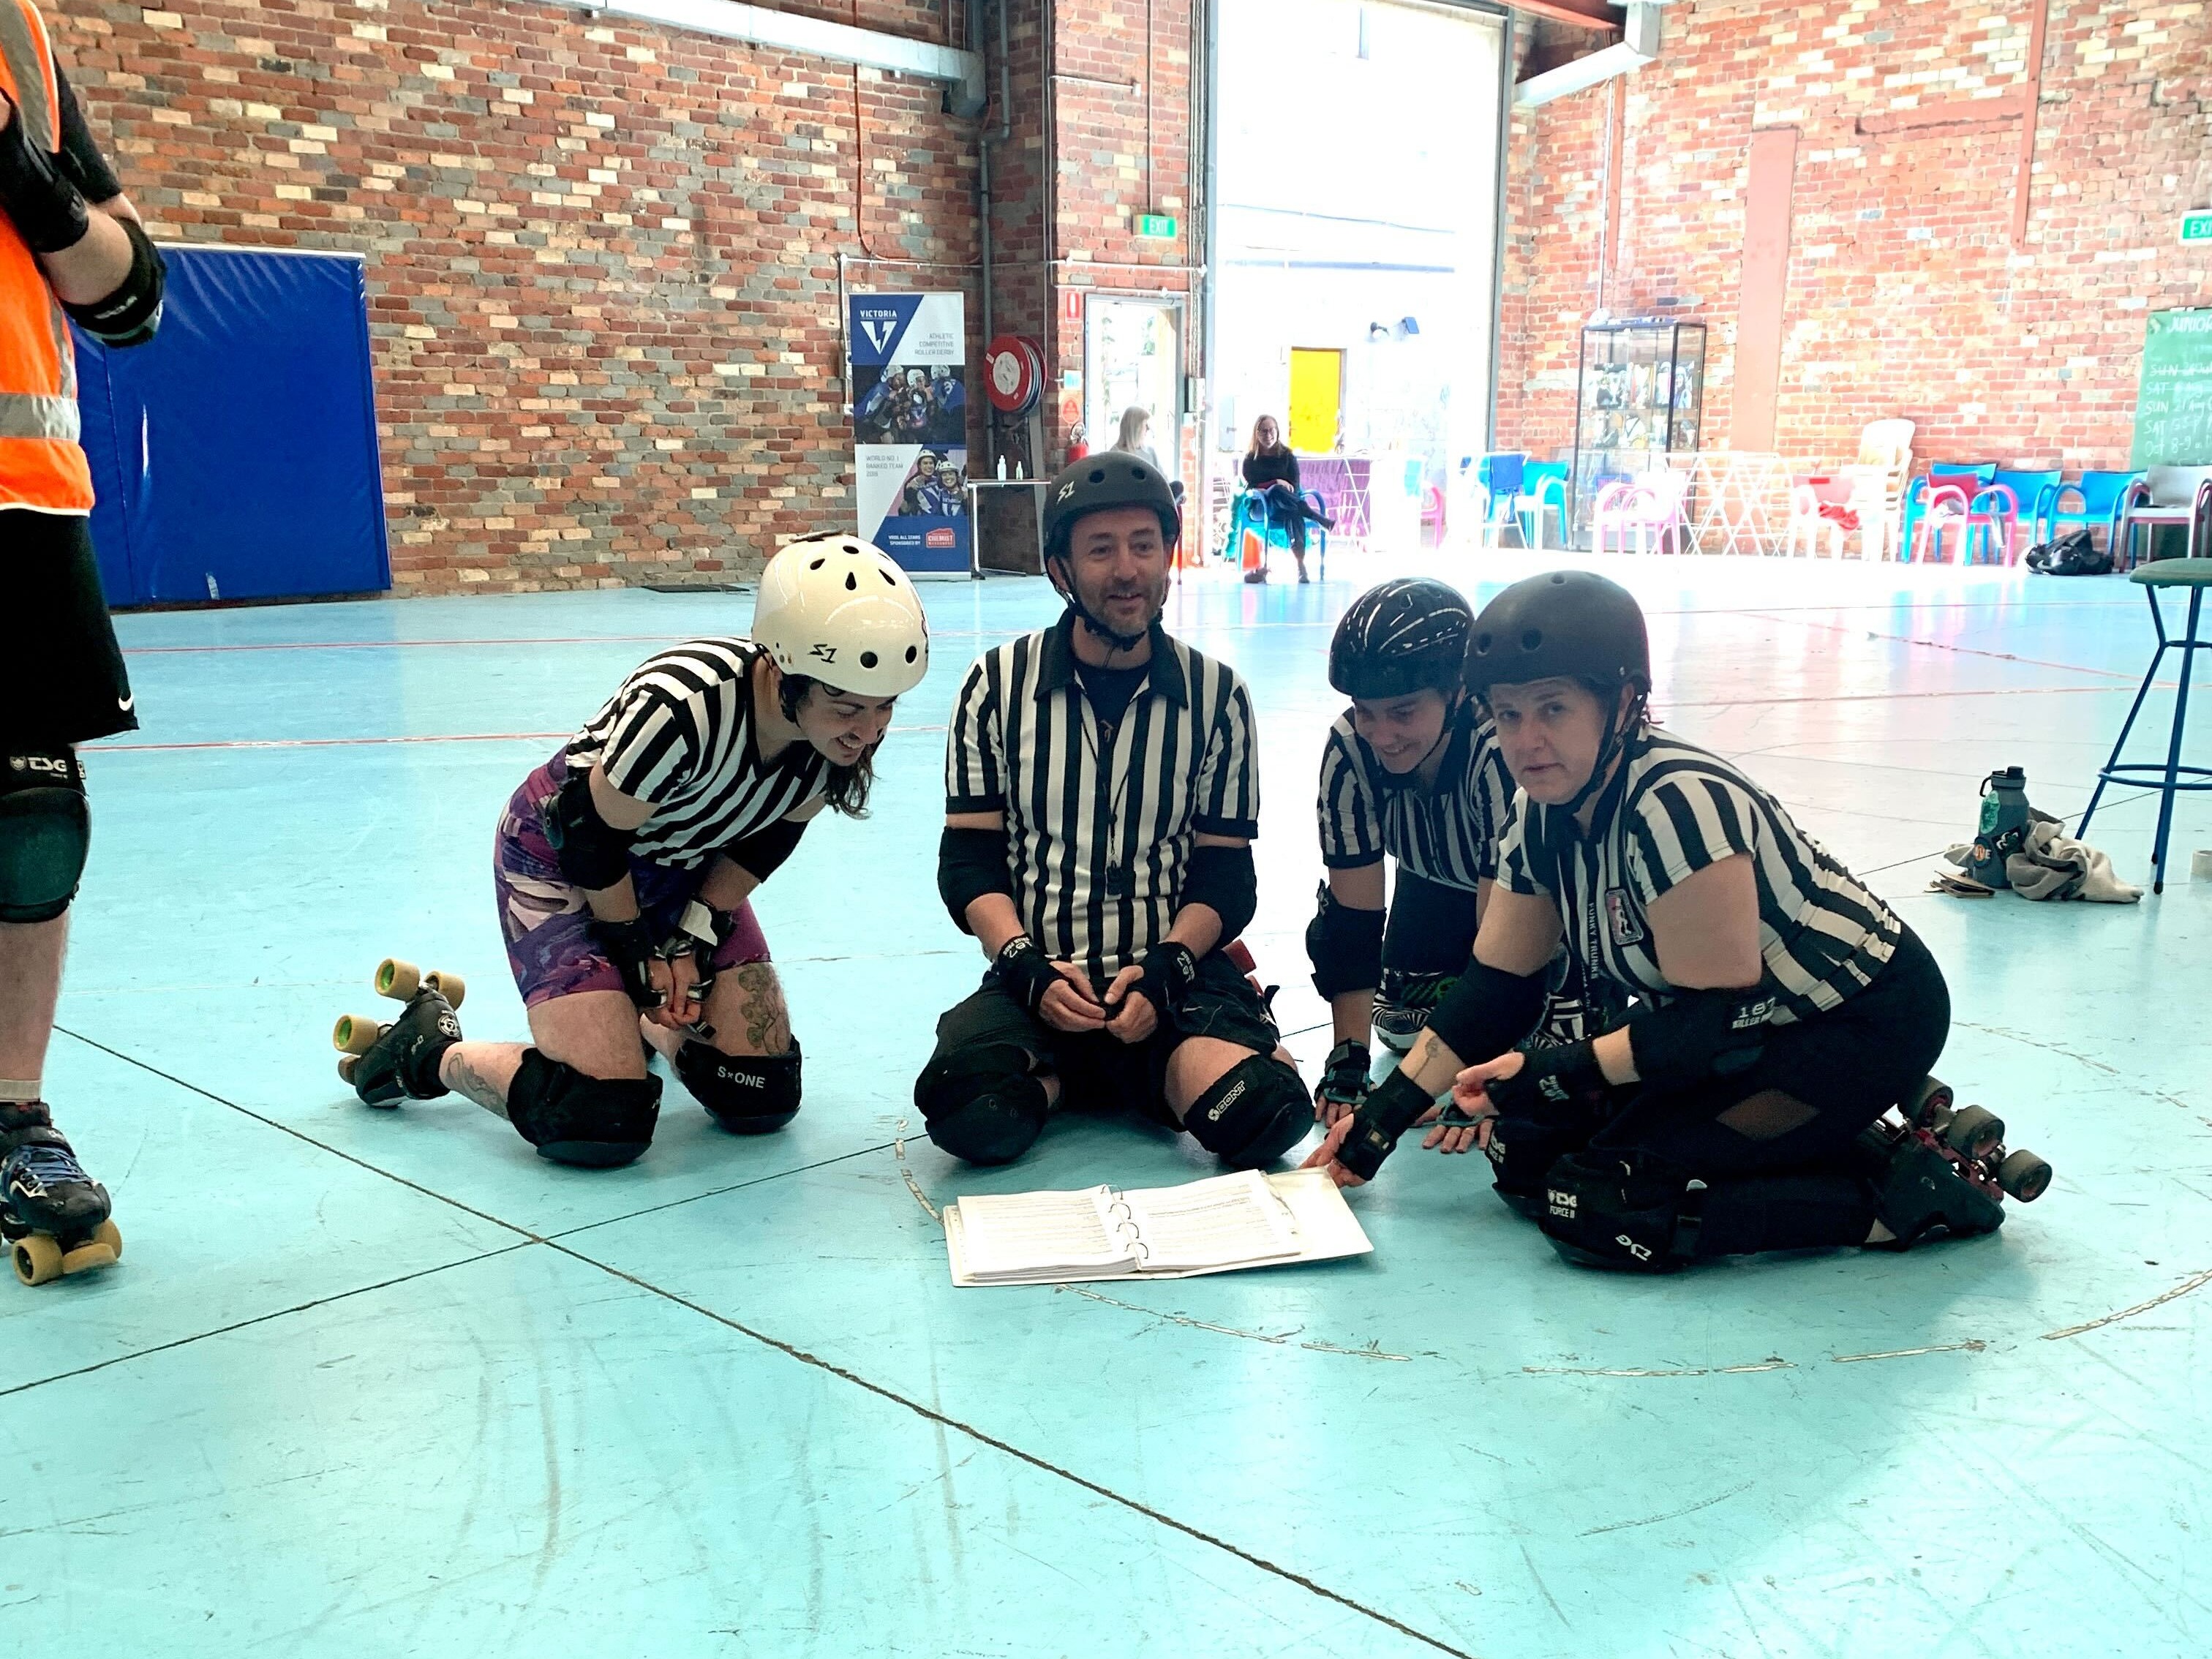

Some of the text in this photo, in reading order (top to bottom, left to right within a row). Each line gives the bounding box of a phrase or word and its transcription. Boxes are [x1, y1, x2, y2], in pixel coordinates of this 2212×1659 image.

[2189, 220, 2212, 237] EXI
[859, 309, 898, 317] VICTORIA
[2144, 400, 2170, 416] SUN
[2143, 419, 2166, 437] SAT
[1588, 902, 1597, 936] FUNKY
[1216, 1080, 1246, 1114] BONT
[1550, 1205, 1569, 1217] FORCE
